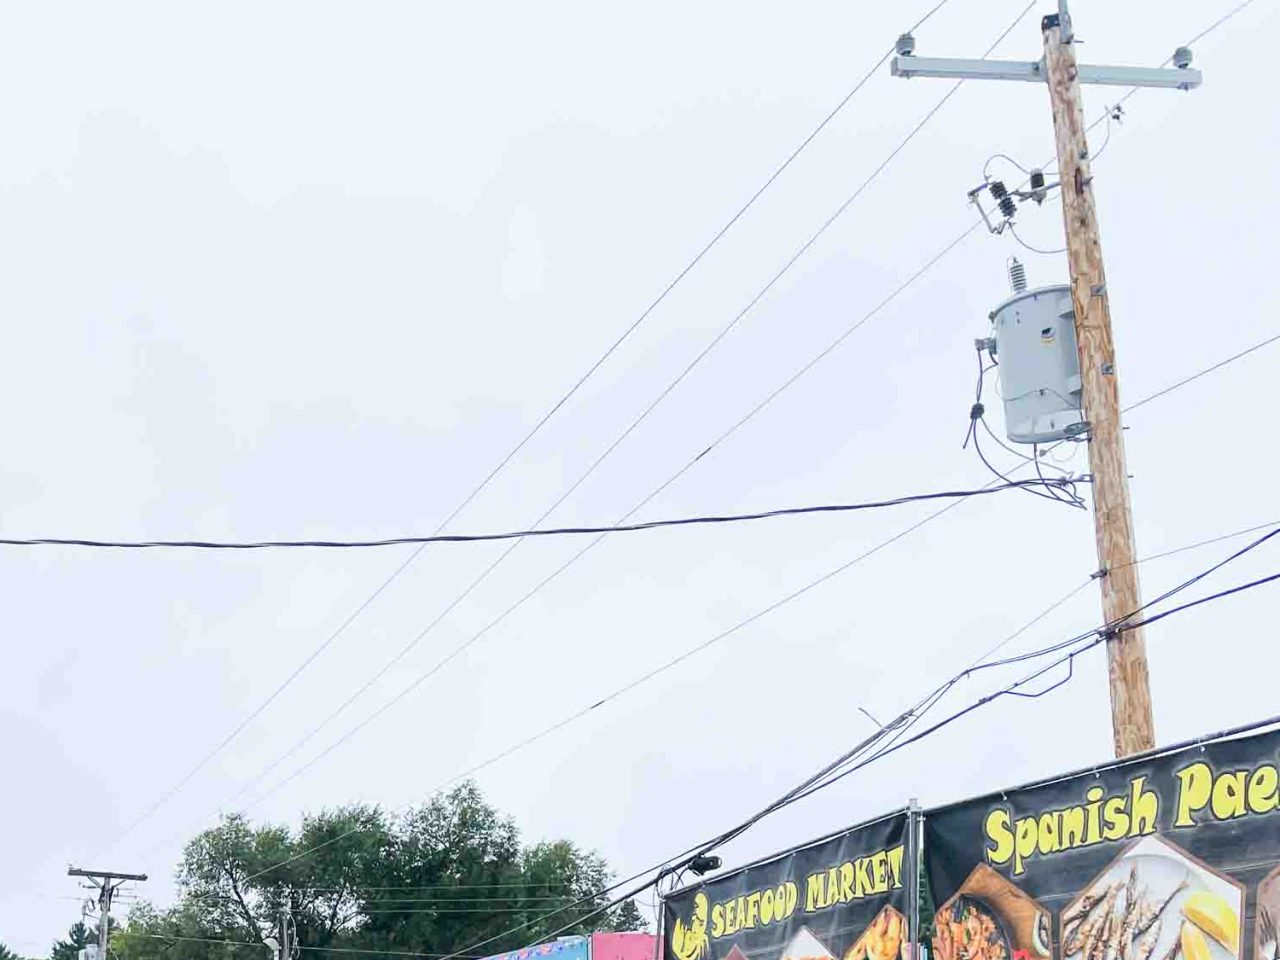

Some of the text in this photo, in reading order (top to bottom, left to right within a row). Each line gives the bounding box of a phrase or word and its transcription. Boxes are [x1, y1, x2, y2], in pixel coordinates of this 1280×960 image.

[985, 776, 1158, 875] Spanish
[710, 845, 905, 939] SEAFOOD MARKET
